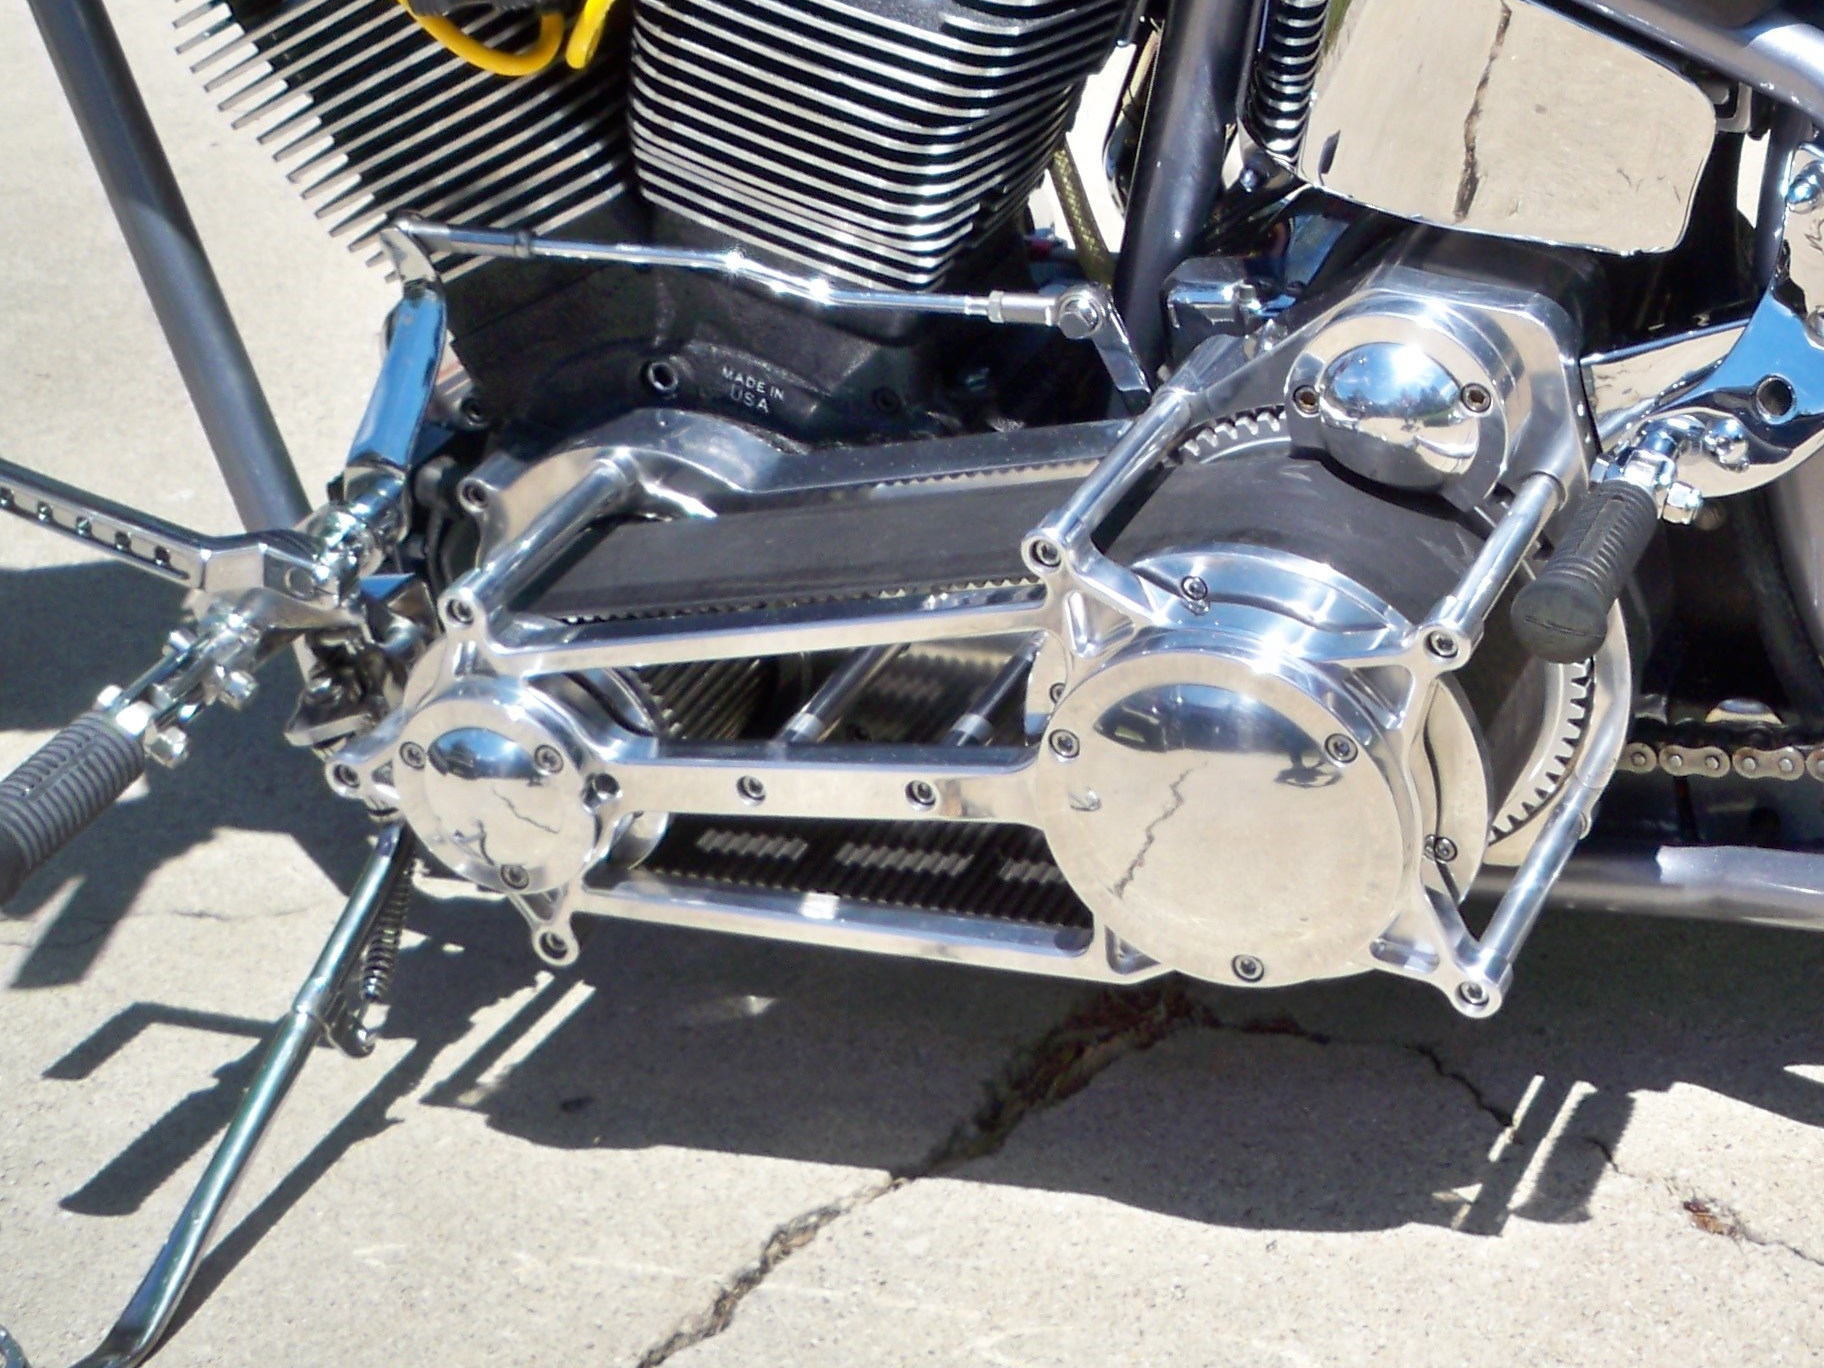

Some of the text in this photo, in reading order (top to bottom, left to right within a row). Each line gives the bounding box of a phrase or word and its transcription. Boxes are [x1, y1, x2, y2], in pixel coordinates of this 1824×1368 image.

[721, 366, 784, 402] MADE IN
[730, 383, 769, 413] USA
